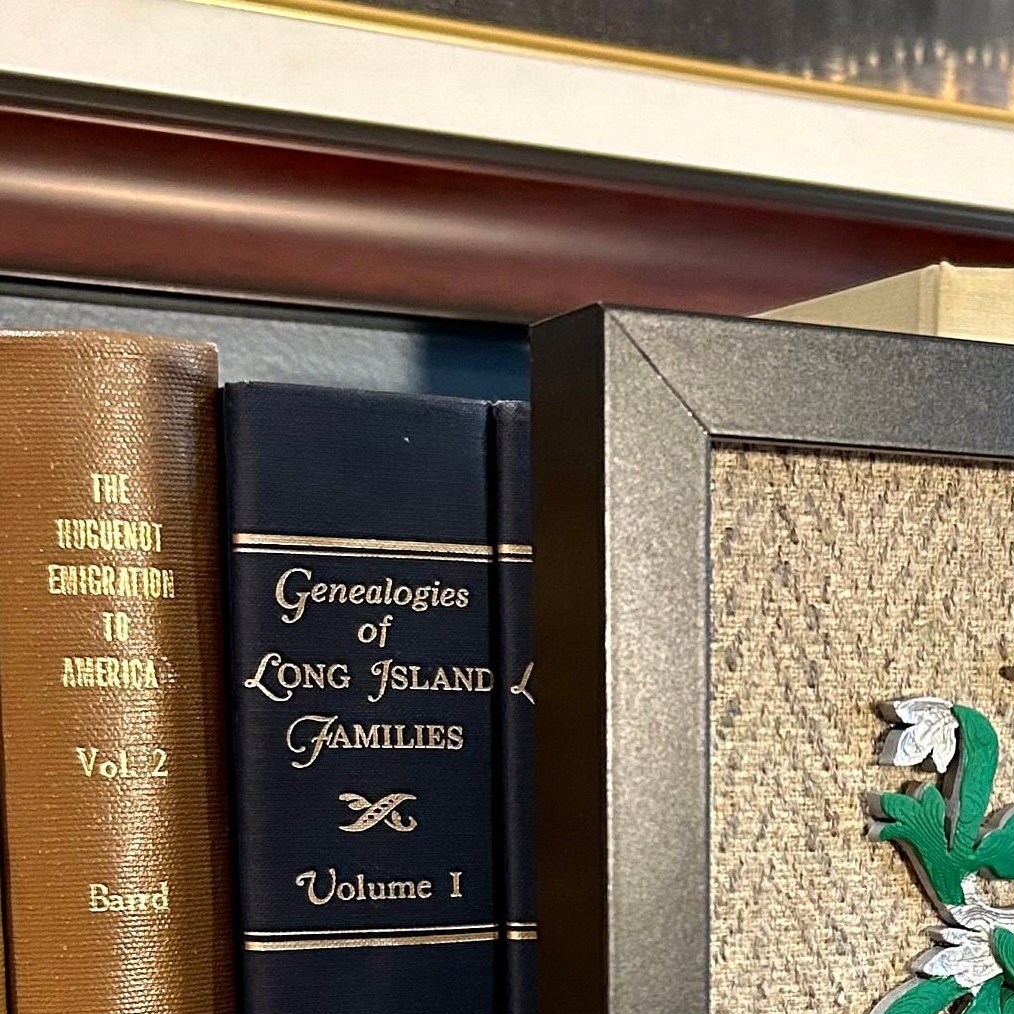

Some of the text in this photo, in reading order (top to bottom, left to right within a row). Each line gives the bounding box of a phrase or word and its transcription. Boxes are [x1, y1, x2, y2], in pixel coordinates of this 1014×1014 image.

[90, 473, 131, 505] THE
[55, 518, 163, 552] HUGUENOT
[47, 563, 175, 599] EMIGRATION
[274, 568, 470, 624] Genealogies
[101, 611, 130, 643] TO
[357, 615, 393, 649] of
[62, 655, 159, 689] AMERICA
[243, 652, 351, 702] LONG
[367, 659, 494, 703] ISLAND
[286, 714, 464, 769] FAMILIES
[151, 748, 169, 778] 2
[88, 880, 170, 913] Baird
[295, 868, 463, 905] Volume I
